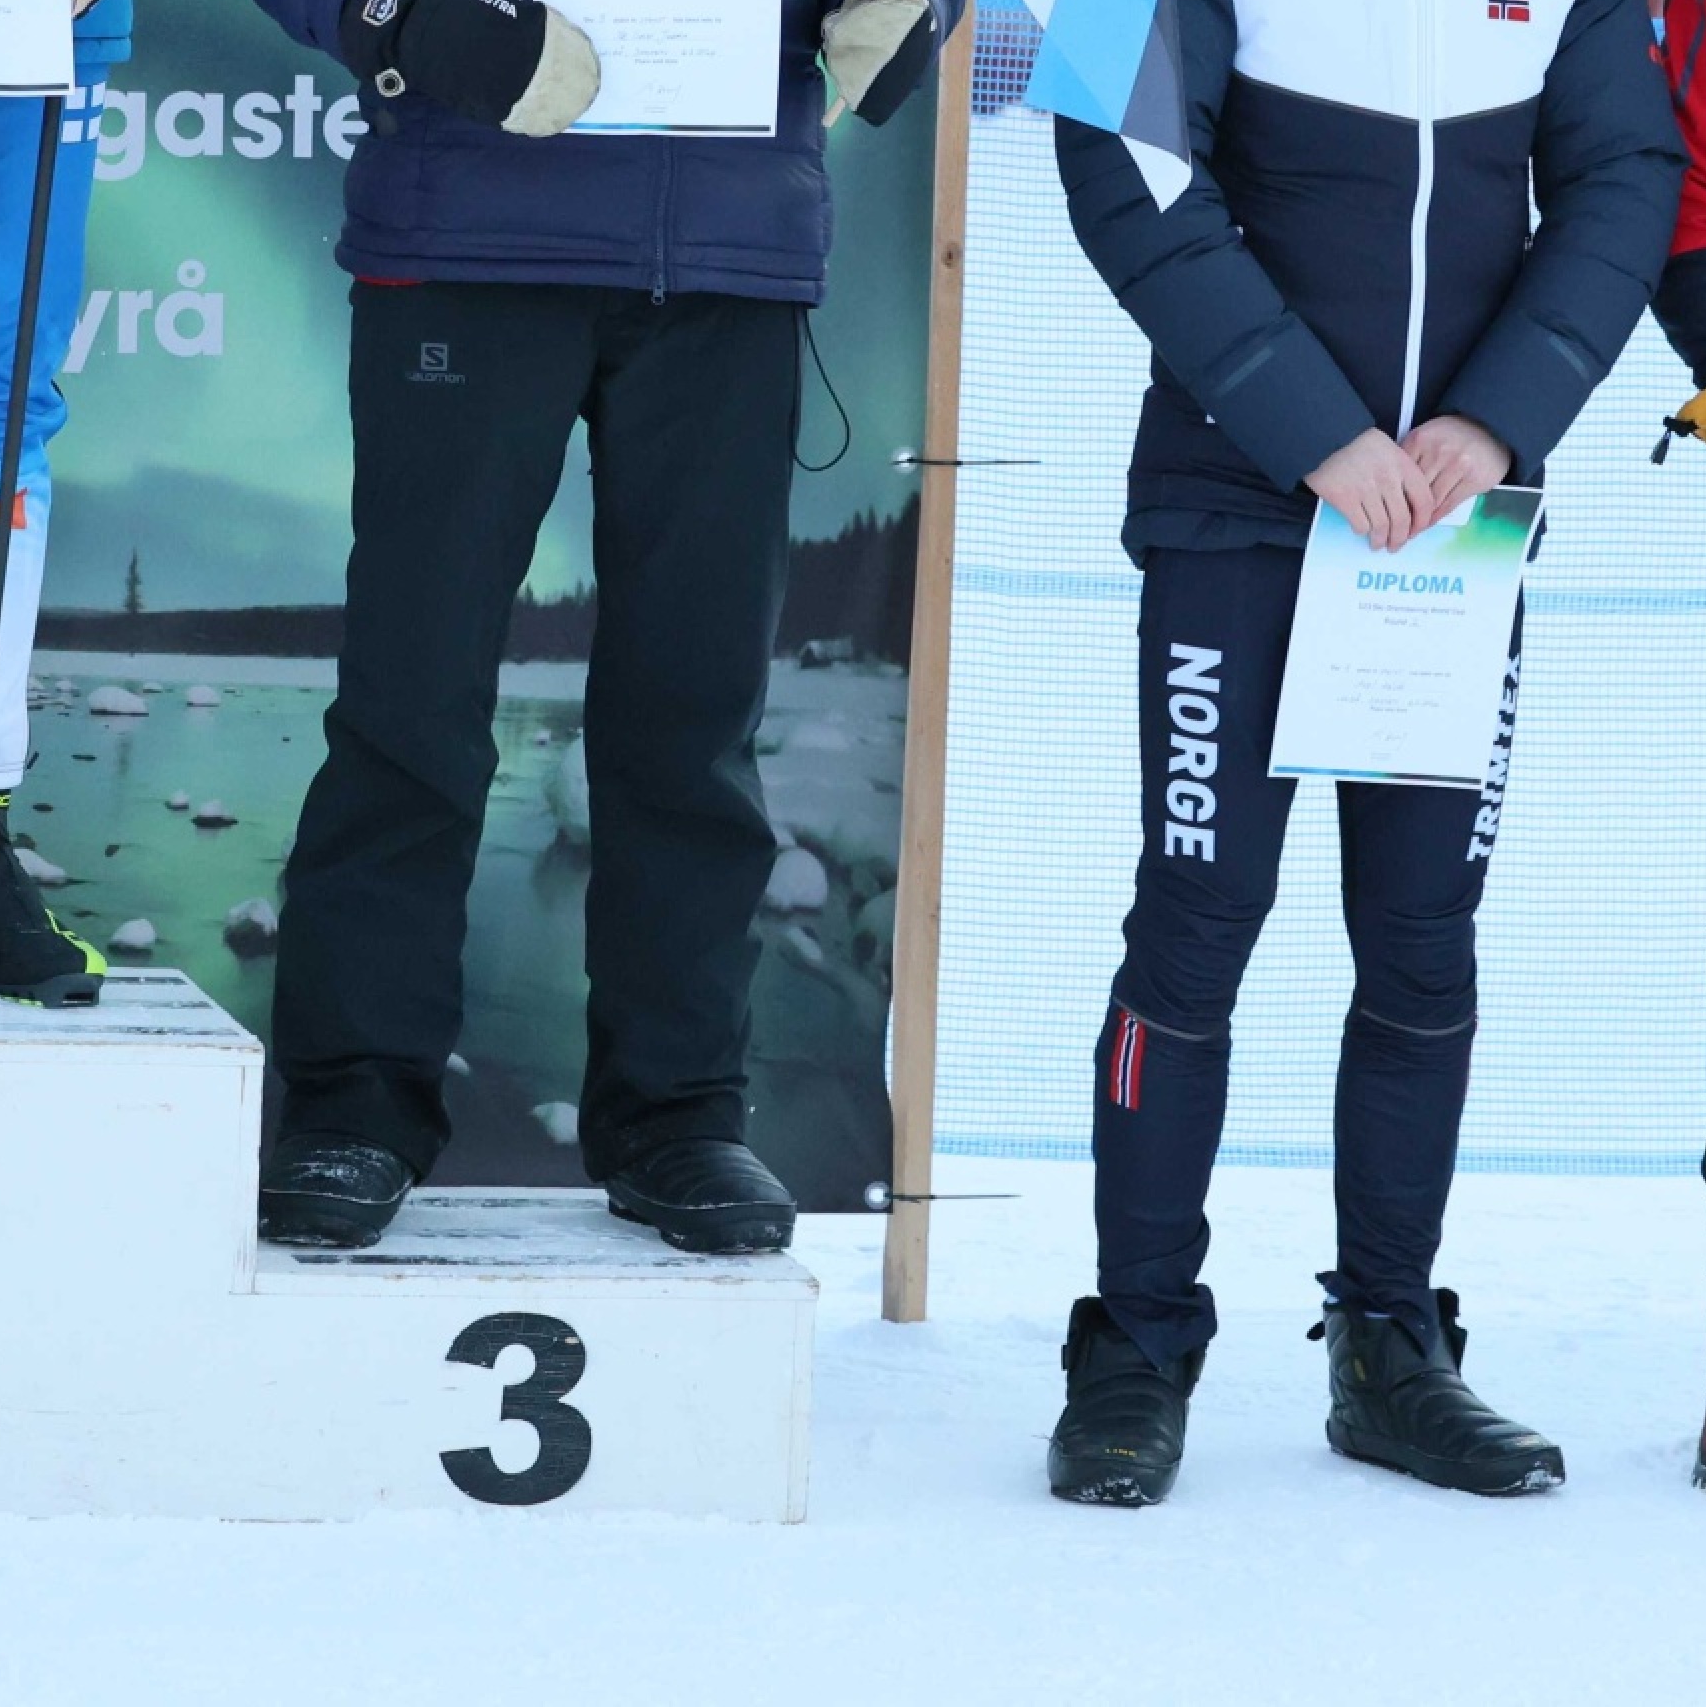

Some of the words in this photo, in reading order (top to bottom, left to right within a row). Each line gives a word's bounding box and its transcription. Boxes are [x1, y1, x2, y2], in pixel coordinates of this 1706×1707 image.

[1356, 570, 1464, 596] DIPLOMA
[1163, 642, 1222, 863] NORGE
[1465, 650, 1521, 863] TRIMTEX
[438, 1311, 594, 1505] 3
